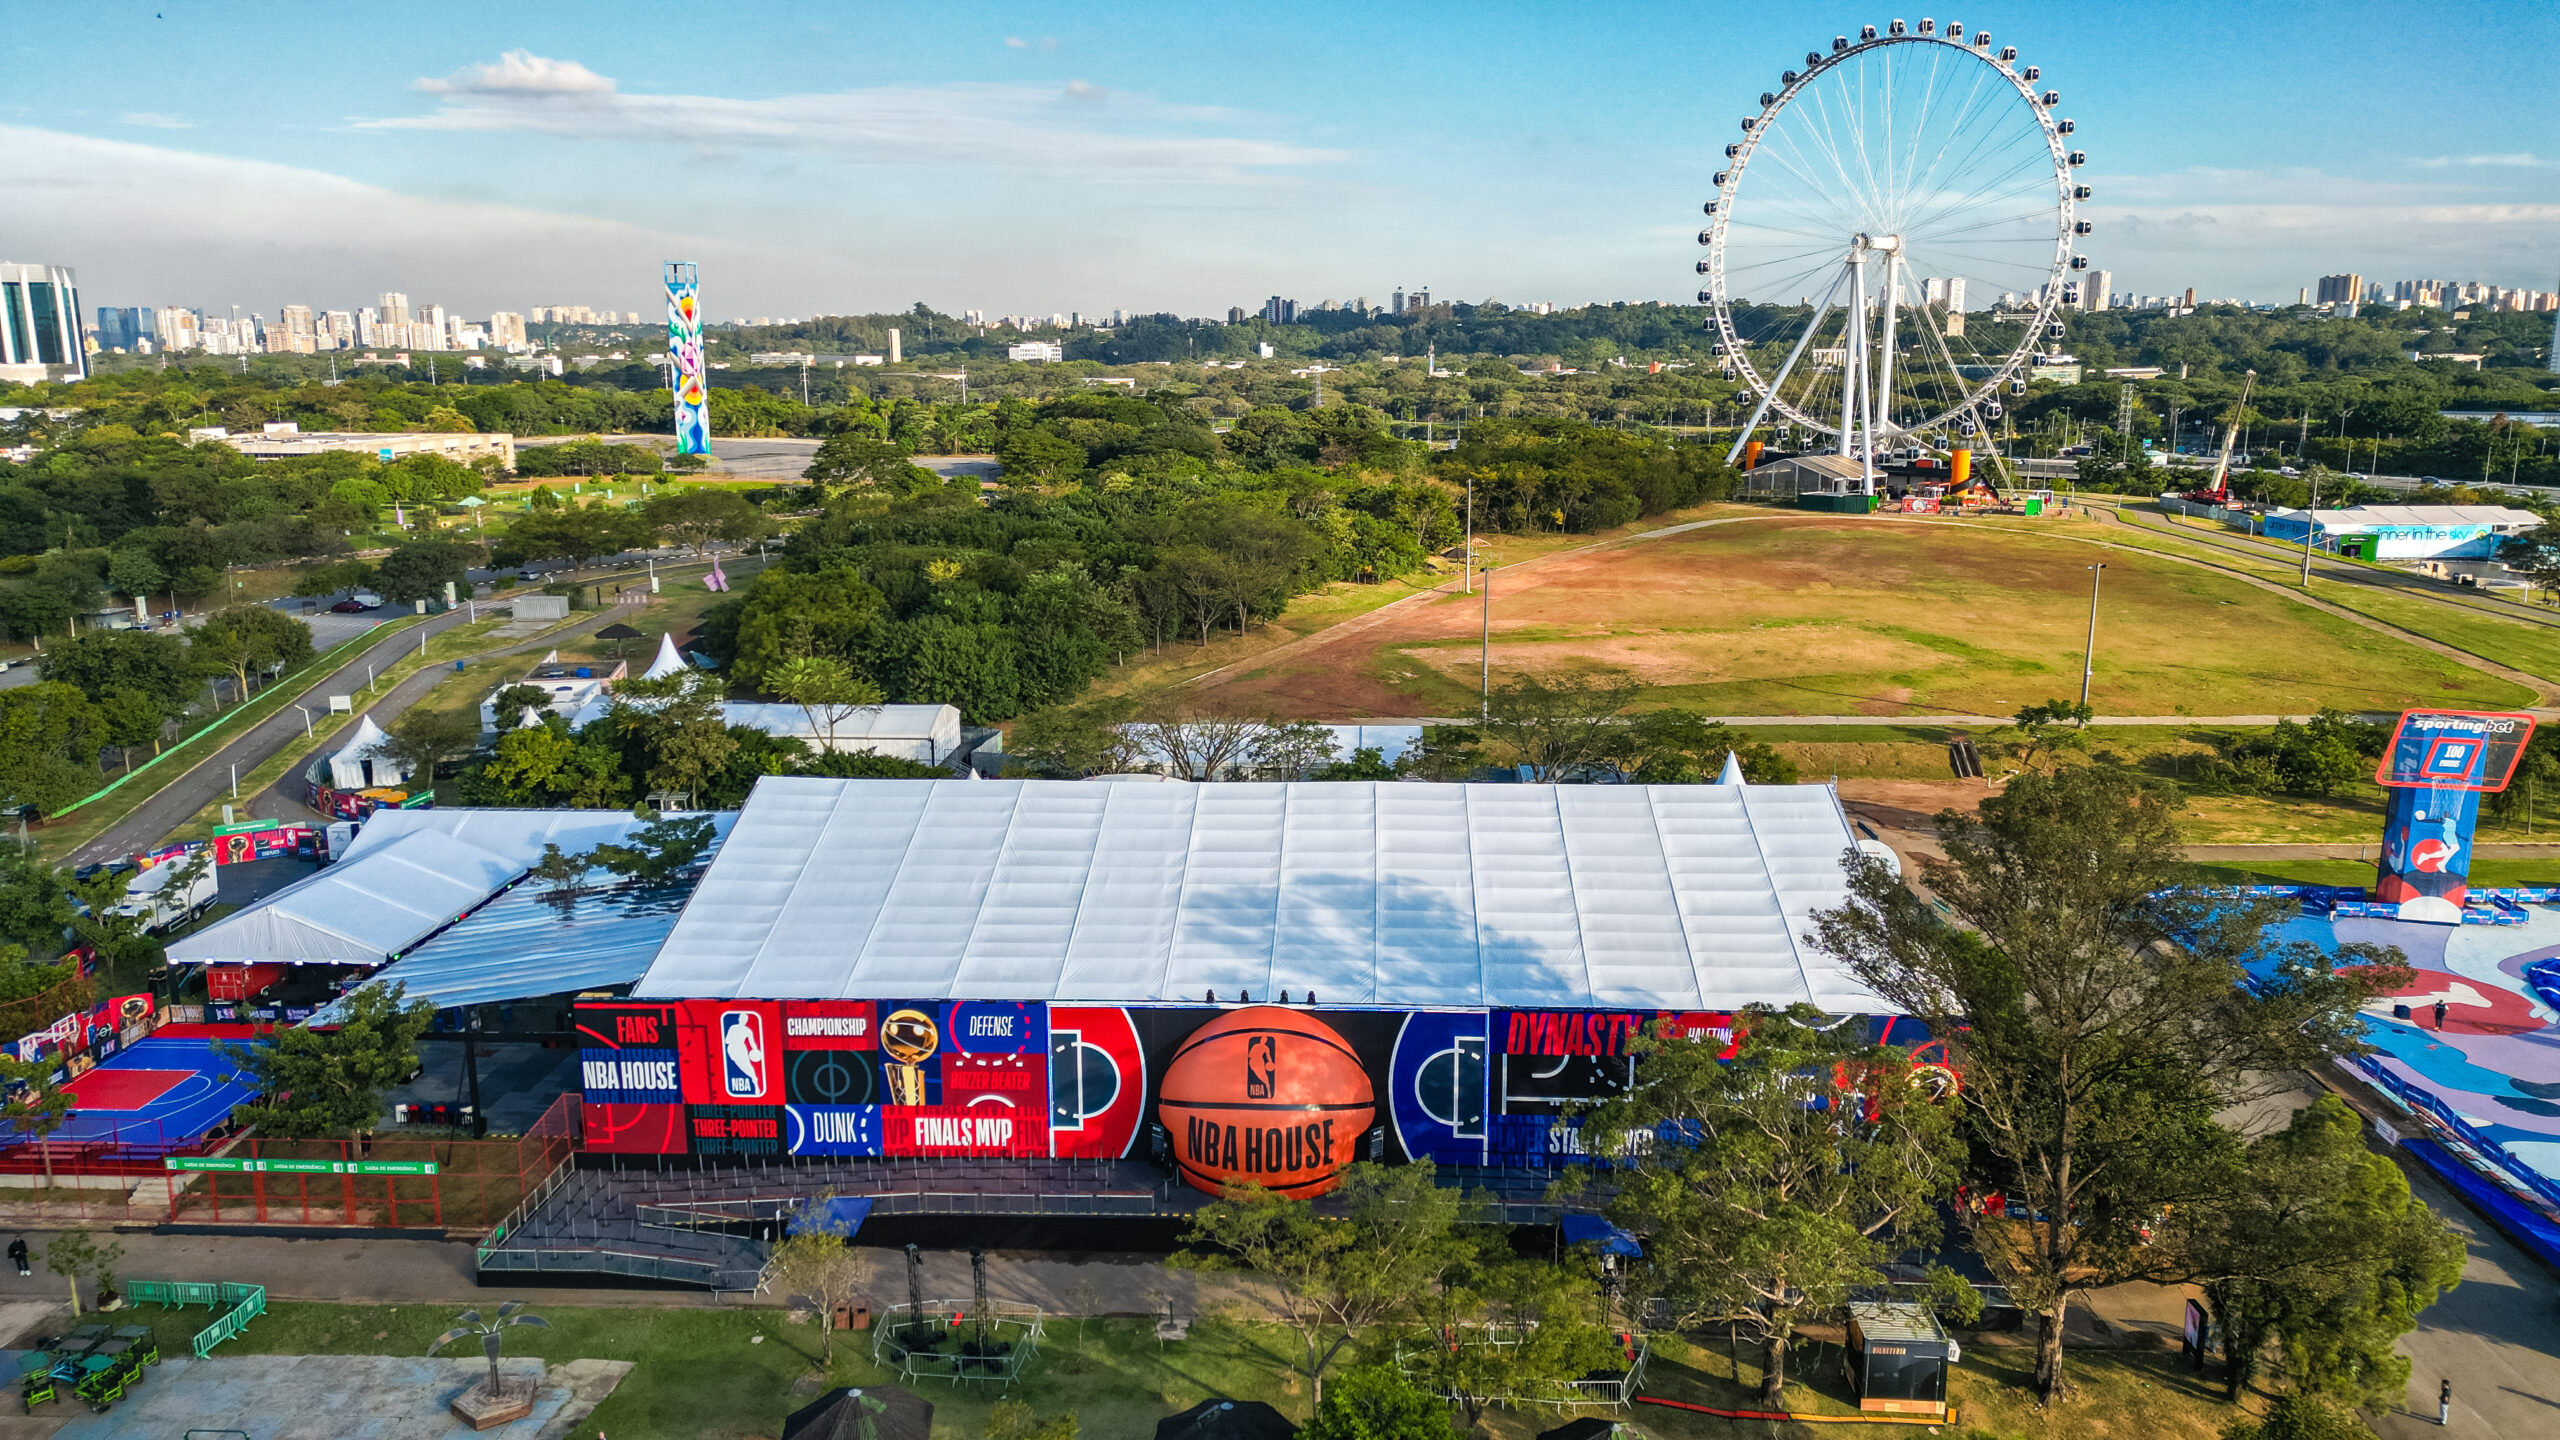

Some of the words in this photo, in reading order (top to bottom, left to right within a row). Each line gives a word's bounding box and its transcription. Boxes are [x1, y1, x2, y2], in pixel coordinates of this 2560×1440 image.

[2371, 528, 2411, 541] dinner
[2412, 528, 2423, 541] in
[2425, 528, 2446, 541] the
[2449, 528, 2468, 542] sky
[2414, 719, 2515, 733] sportingbet
[2443, 744, 2466, 759] 100
[616, 1016, 659, 1043] FANS
[787, 1017, 867, 1036] CHAMPIONSHIP
[969, 1015, 1014, 1037] DEFENSE
[1506, 1012, 1643, 1057] DYNASTY
[582, 1061, 620, 1090] NBA
[620, 1061, 677, 1090] HOUSE
[731, 1077, 751, 1092] NBA
[951, 1071, 989, 1090] BUZZER
[991, 1071, 1031, 1091] BEATER
[1250, 1084, 1265, 1096] NBA
[693, 1118, 778, 1139] THREE-POINTER
[813, 1111, 857, 1143] DUNK
[914, 1117, 973, 1146] FINALS
[975, 1118, 1013, 1147] MVP
[1187, 1115, 1239, 1172] NBA
[1245, 1118, 1334, 1174] HOUSE
